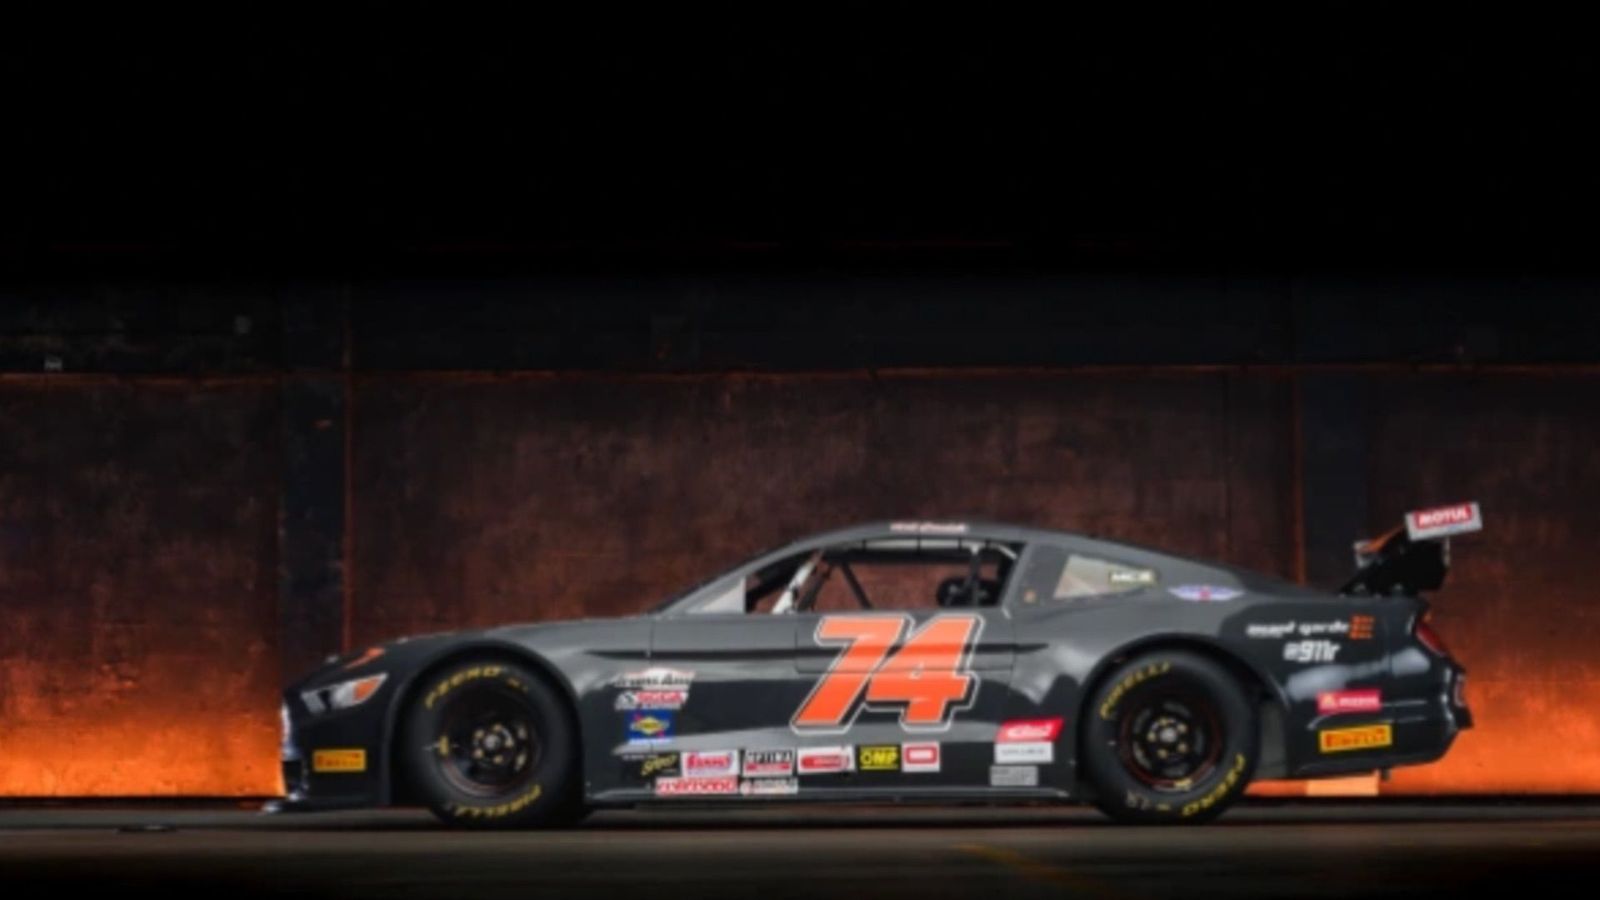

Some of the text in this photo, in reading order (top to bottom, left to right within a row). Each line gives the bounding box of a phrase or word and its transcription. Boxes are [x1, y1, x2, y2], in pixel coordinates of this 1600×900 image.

[1418, 504, 1471, 527] MOTUL
[791, 611, 984, 731] 74
[860, 747, 898, 766] OMP
